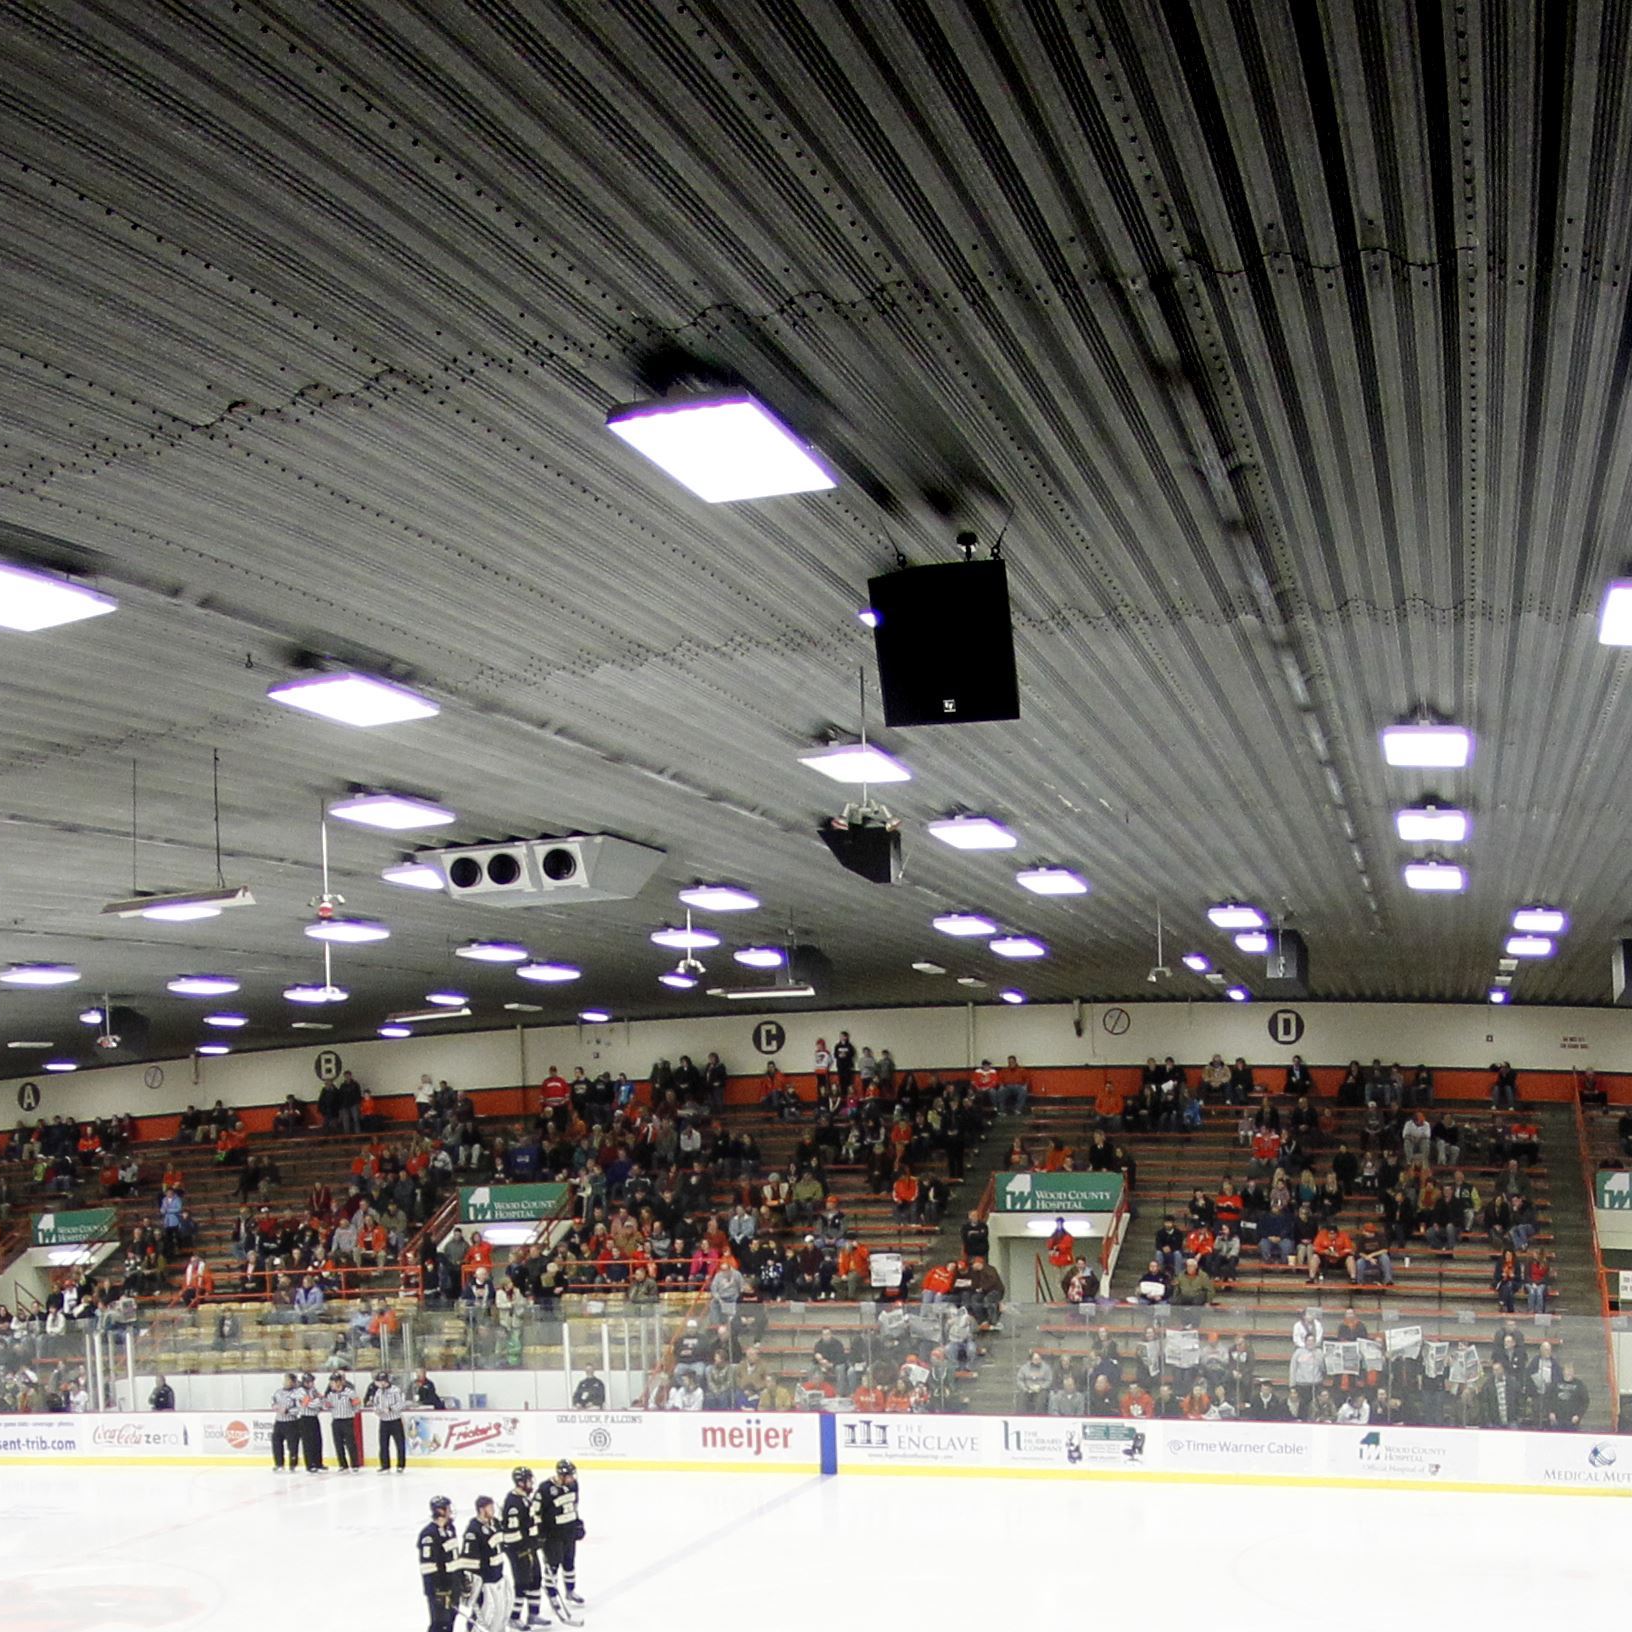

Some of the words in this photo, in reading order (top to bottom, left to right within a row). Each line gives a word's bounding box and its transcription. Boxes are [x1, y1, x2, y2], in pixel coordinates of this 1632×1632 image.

[1277, 1015, 1296, 1039] D
[761, 1025, 777, 1050] C
[321, 1052, 337, 1079] B
[23, 1086, 35, 1107] A
[1068, 1190, 1111, 1200] COUNTY
[1035, 1200, 1084, 1209] HOSPITAL
[701, 1419, 793, 1455] meijer
[898, 1436, 979, 1451] ENCLAVE
[1186, 1440, 1217, 1451] Time
[1219, 1441, 1265, 1453] Warner
[1267, 1442, 1304, 1454] Cable
[1544, 1469, 1600, 1482] MEDICAL
